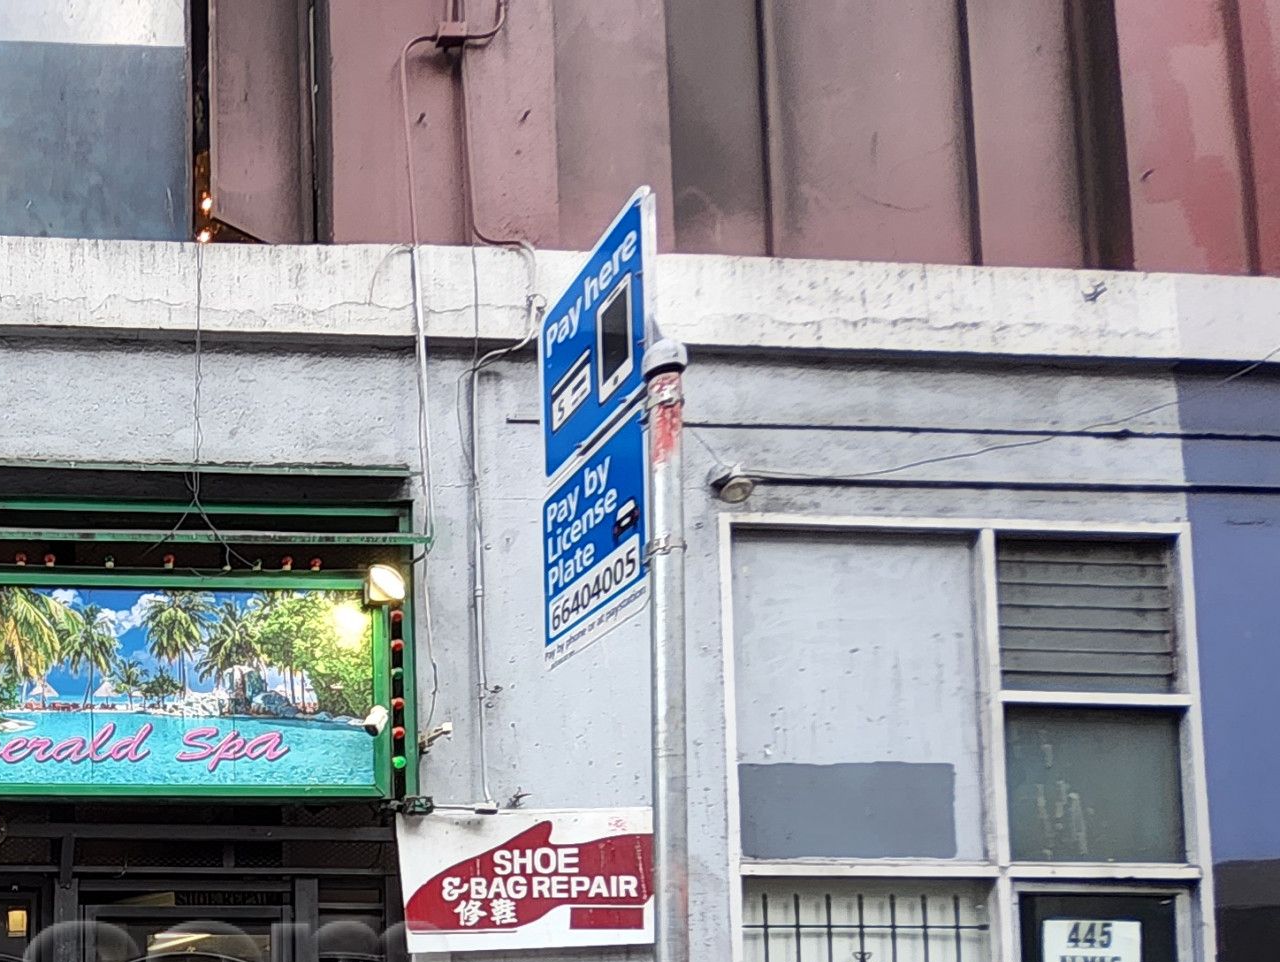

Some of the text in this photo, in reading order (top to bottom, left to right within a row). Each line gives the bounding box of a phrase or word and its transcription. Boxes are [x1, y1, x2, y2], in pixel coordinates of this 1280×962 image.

[547, 230, 637, 358] Pay here
[547, 455, 611, 533] Pay by
[548, 488, 618, 564] License
[548, 542, 595, 597] Plate
[552, 547, 637, 631] 66404005
[175, 725, 290, 772] Spa
[493, 847, 579, 875] SHOE
[532, 875, 638, 898] REPAIR
[1066, 922, 1112, 949] 445
